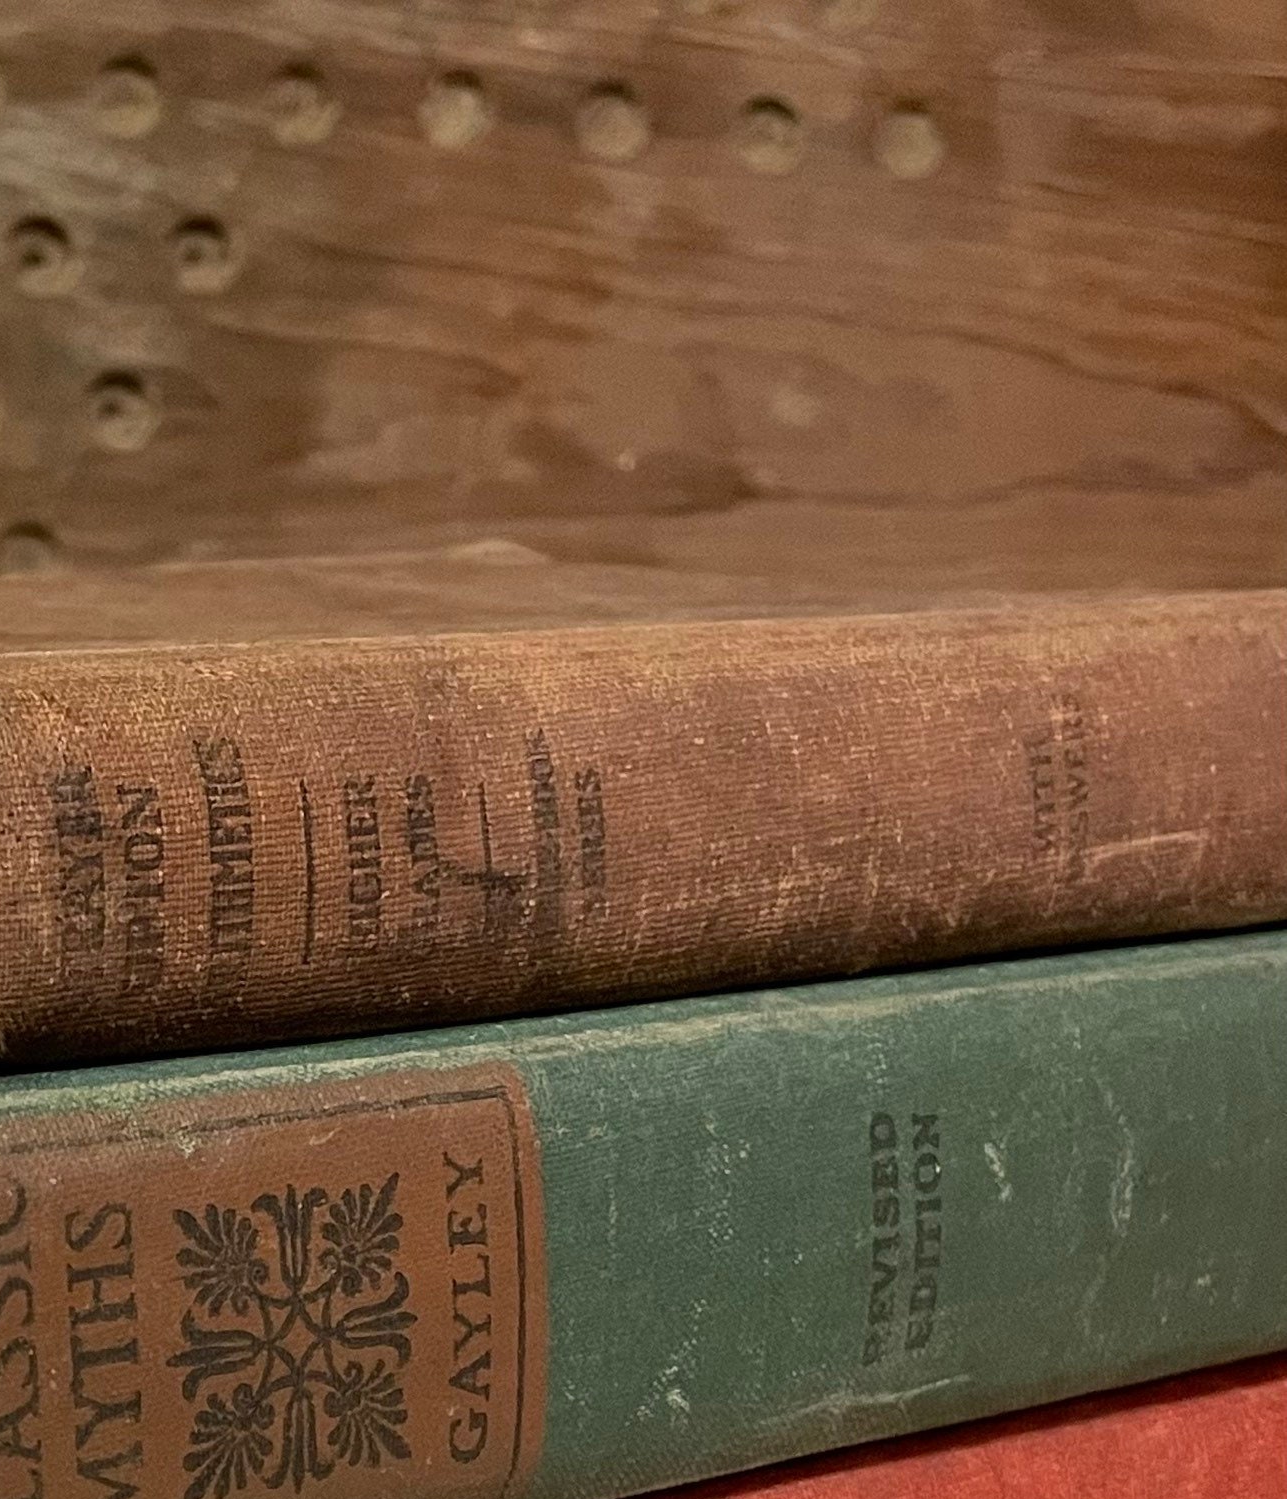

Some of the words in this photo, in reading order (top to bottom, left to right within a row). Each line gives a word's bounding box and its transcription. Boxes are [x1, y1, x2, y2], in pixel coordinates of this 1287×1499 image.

[442, 1150, 493, 1464] GAYLEY
[863, 1111, 901, 1368] REVISED
[903, 1111, 943, 1352] EDITION
